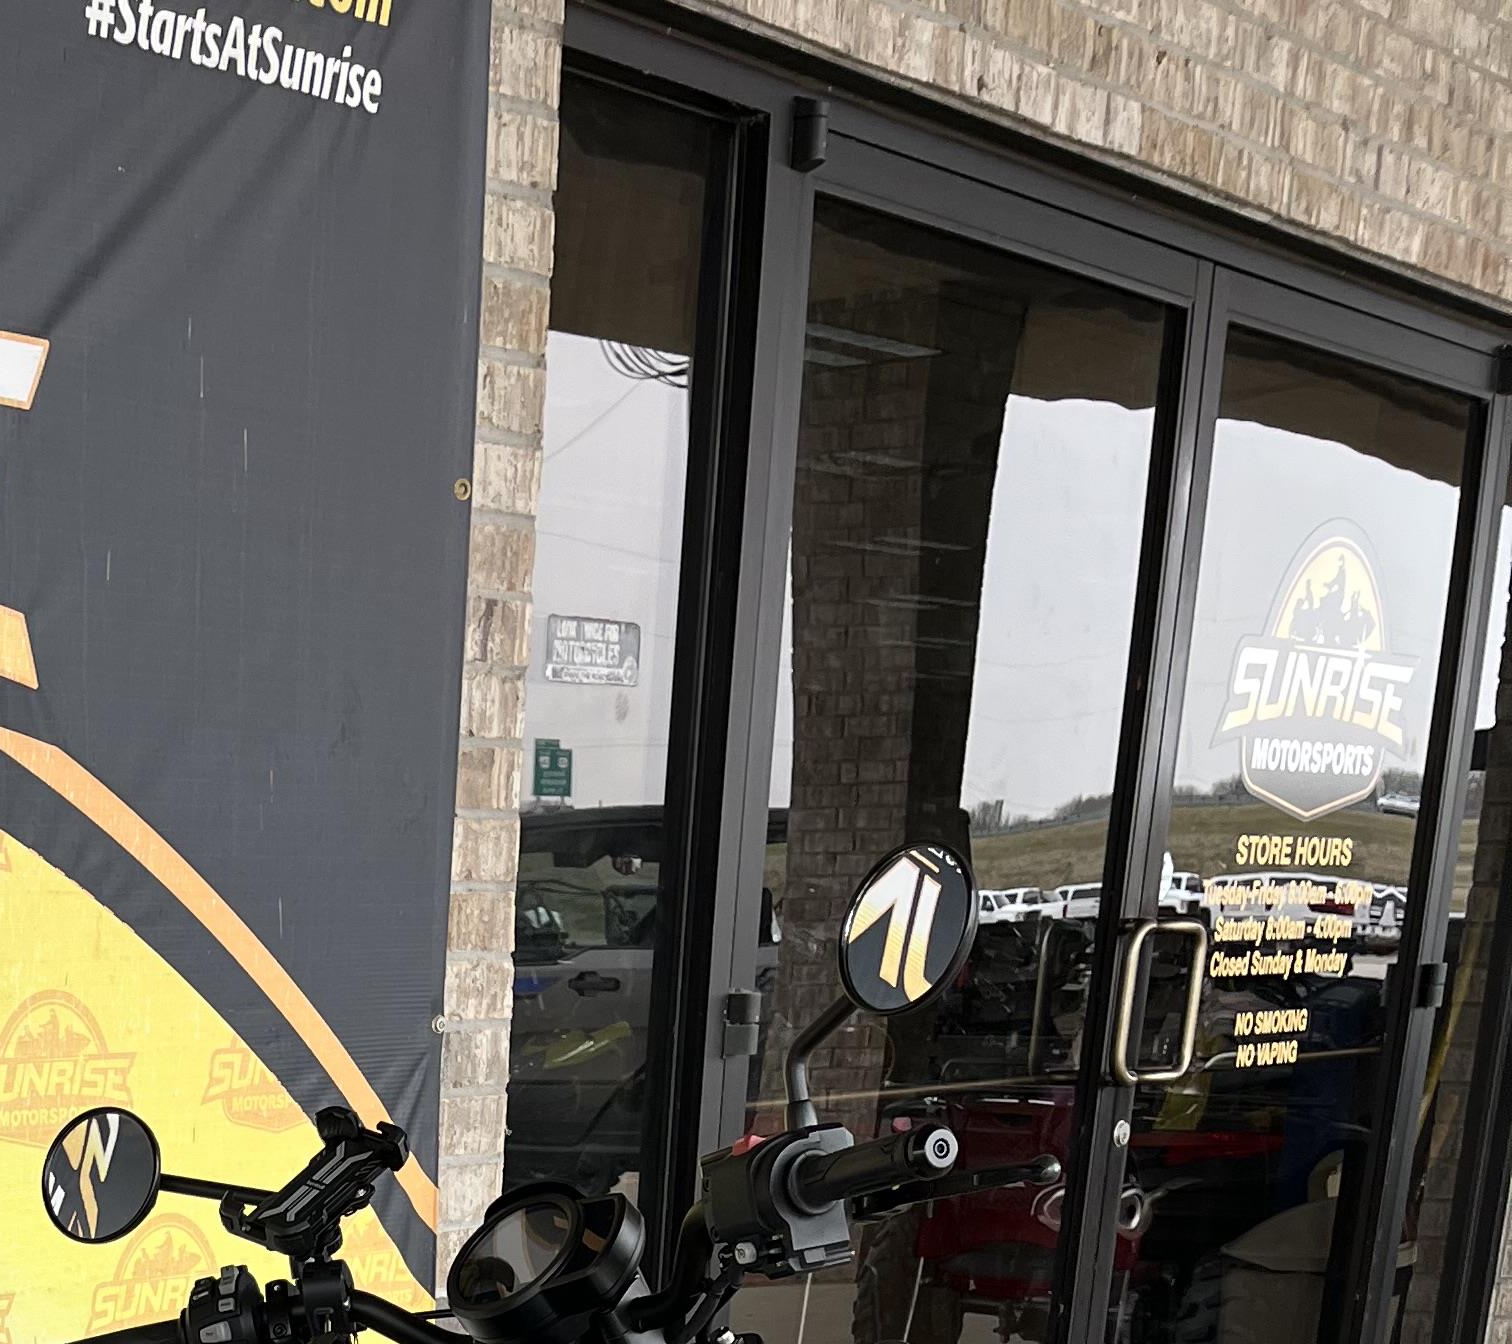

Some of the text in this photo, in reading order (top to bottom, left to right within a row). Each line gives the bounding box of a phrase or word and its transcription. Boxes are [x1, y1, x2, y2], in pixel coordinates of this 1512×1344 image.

[85, 0, 383, 113] #StartsAtSunrise
[1221, 646, 1414, 745] SUNRISE
[1251, 738, 1374, 776] MOTORSPORTS
[1236, 834, 1353, 866] STORE HOURS
[1214, 915, 1265, 945] Saturday
[1209, 949, 1348, 980] Closed Sunday & Monday
[1234, 1008, 1308, 1036] NO SMOKING
[1235, 1040, 1298, 1068] NO VAPING
